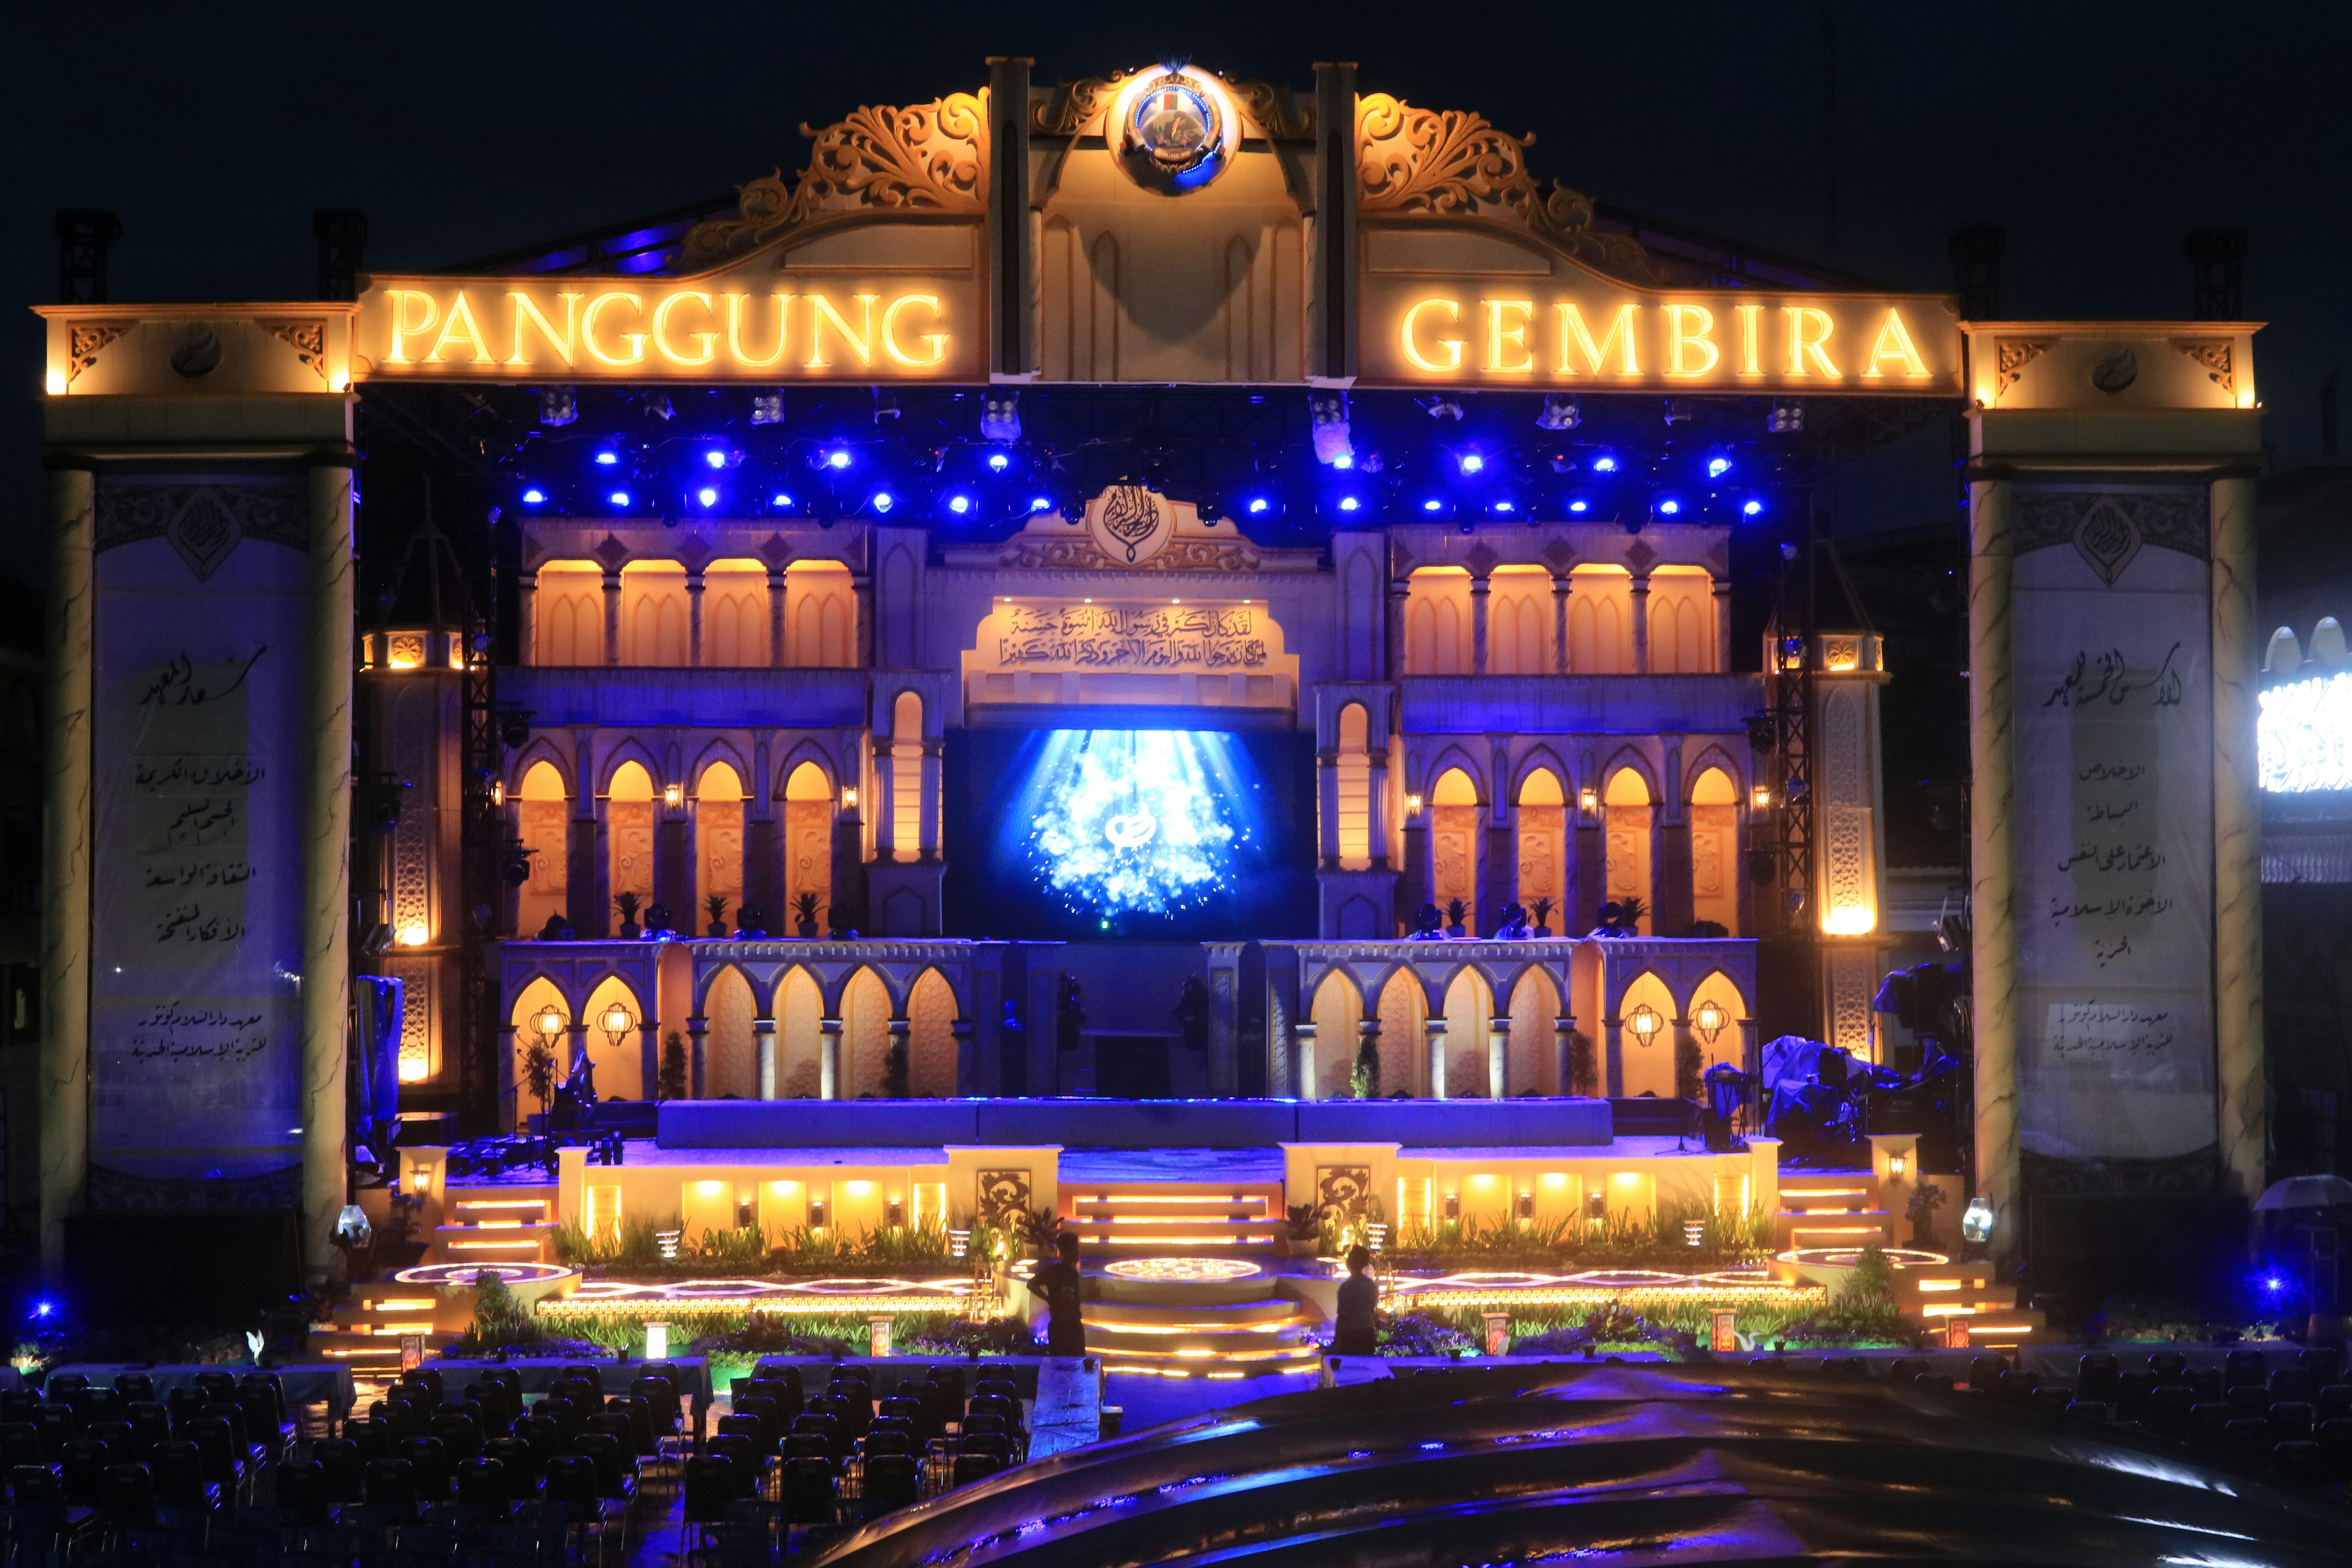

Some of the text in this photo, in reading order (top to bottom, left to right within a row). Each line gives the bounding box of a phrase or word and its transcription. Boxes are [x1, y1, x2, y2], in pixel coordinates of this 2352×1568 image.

[382, 289, 950, 368] PANGGUNG
[1399, 298, 1934, 379] GEMBIRA
[135, 757, 187, 793] الكريمة
[168, 799, 234, 846] الجسم السليم
[2087, 800, 2138, 827] البساطة
[2059, 842, 2099, 872] النفس
[145, 862, 256, 889] الثقافة الواسعة
[2094, 934, 2131, 967] الحرية
[229, 1015, 261, 1031] معهد
[2139, 1012, 2168, 1027] معهد
